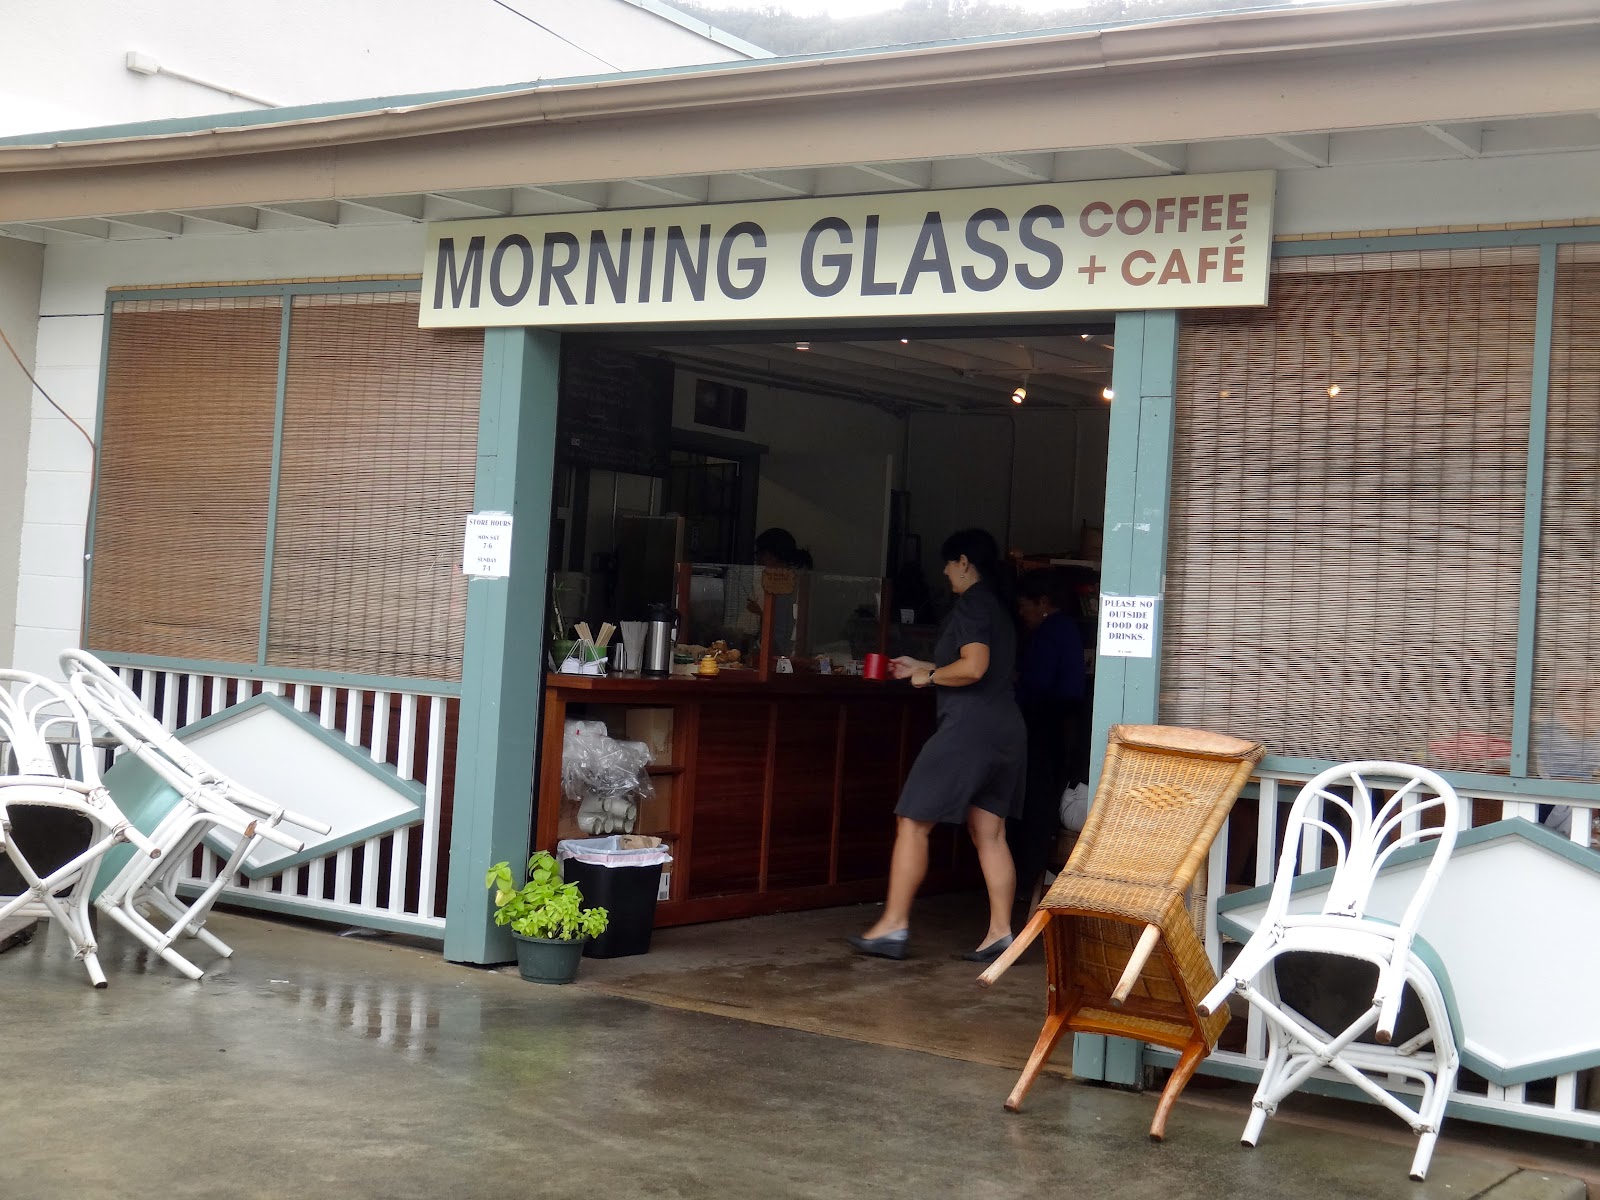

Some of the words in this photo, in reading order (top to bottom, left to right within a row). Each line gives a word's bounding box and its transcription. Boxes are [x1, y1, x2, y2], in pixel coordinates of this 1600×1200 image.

[1079, 193, 1249, 237] COFFEE
[433, 221, 767, 309] MORNING
[800, 204, 1065, 298] GLASS
[1121, 233, 1245, 286] CAFÉ
[469, 518, 488, 526] STORE
[1104, 599, 1136, 608] PLEASE
[1139, 600, 1153, 608] NO
[1109, 610, 1147, 619] OUTSIDE
[1107, 621, 1132, 629] FOOD
[1135, 622, 1149, 630] OR
[1108, 632, 1145, 640] DRINKS.
